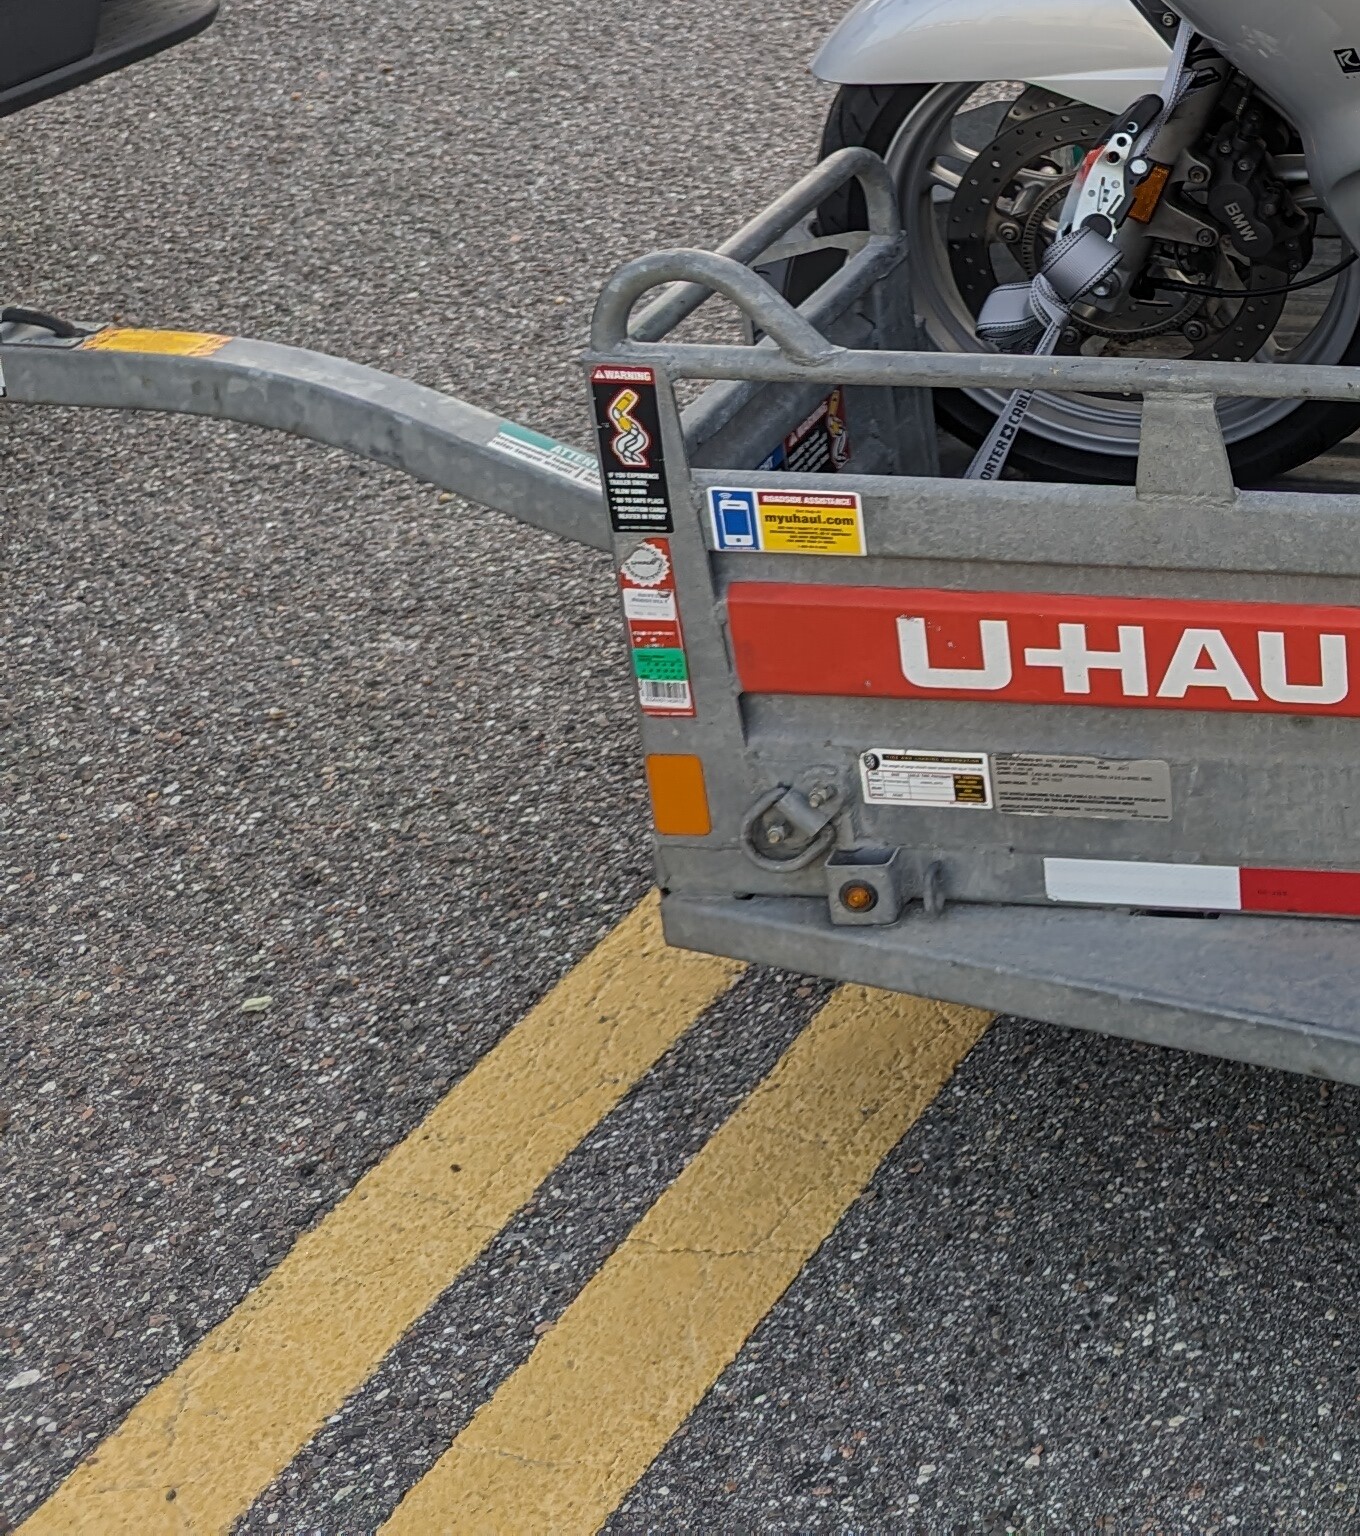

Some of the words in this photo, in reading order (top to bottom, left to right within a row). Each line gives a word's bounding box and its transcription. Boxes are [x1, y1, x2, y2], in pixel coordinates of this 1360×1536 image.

[1224, 202, 1258, 241] BMW
[604, 370, 651, 381] WARNING
[981, 439, 1008, 480] ORTER
[764, 513, 854, 525] myuhaul.com
